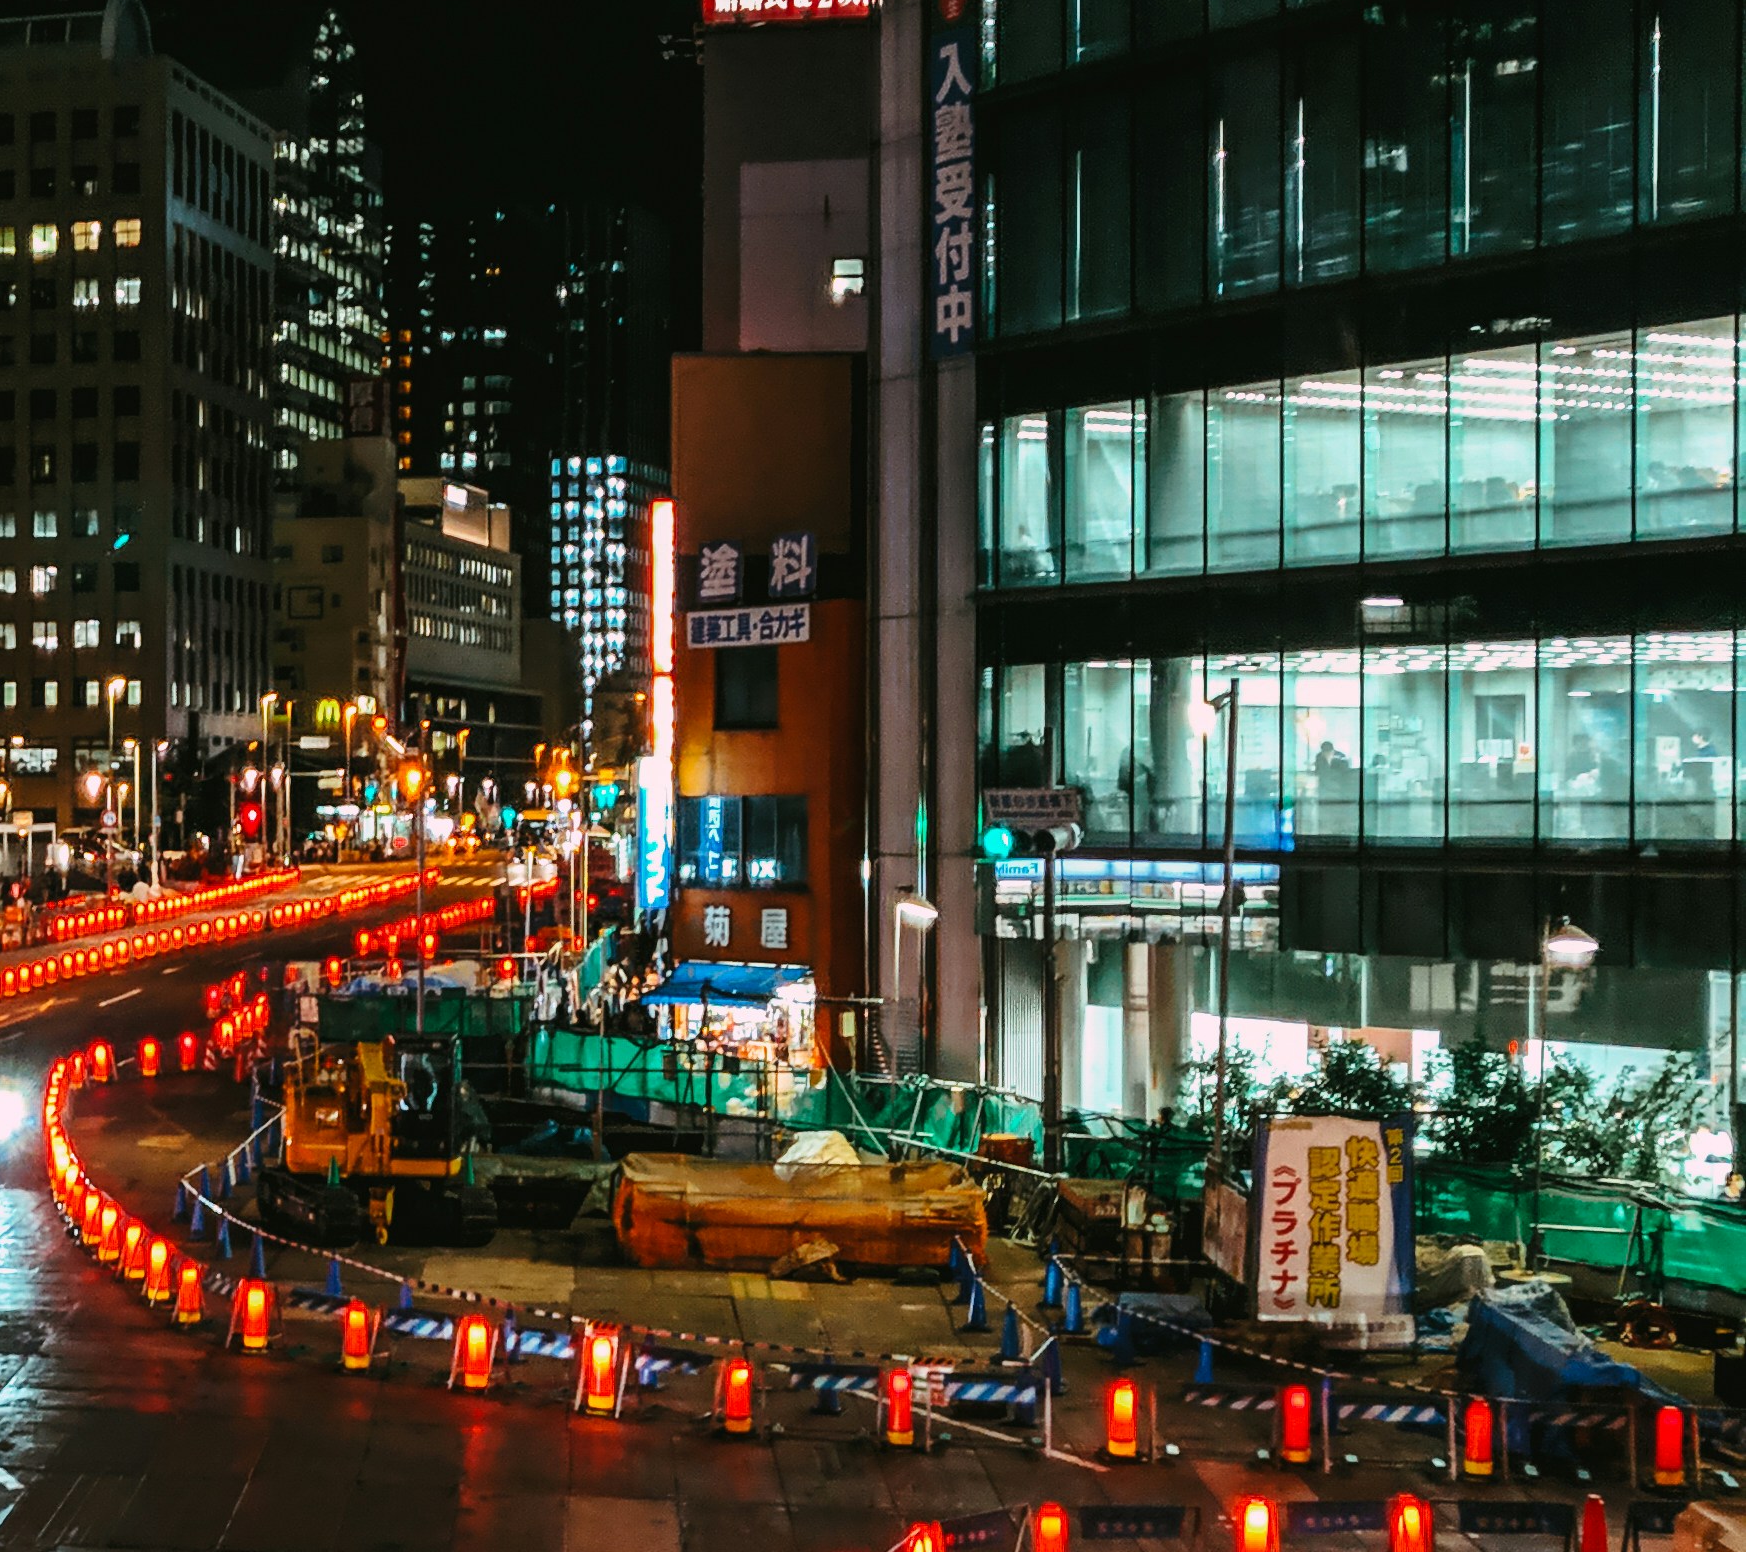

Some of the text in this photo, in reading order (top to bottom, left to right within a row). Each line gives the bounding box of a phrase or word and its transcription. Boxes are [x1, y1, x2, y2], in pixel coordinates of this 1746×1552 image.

[934, 42, 974, 344] 入塾受付中
[699, 533, 812, 598] 塗料
[703, 904, 789, 949] 菊屋
[1306, 1145, 1342, 1309] 認定作業所
